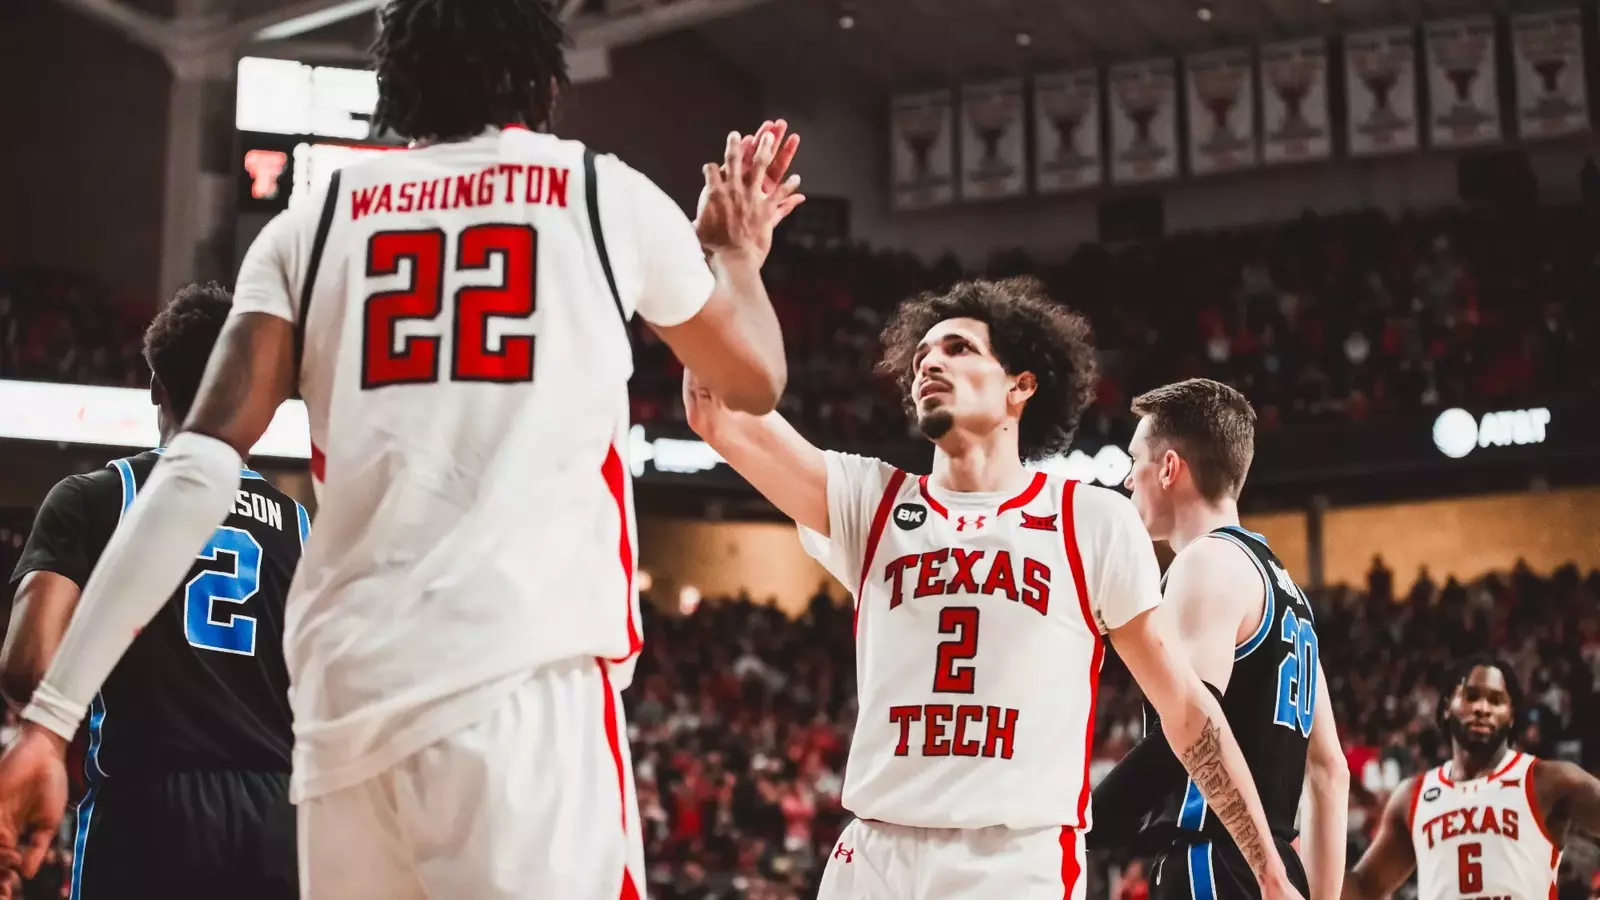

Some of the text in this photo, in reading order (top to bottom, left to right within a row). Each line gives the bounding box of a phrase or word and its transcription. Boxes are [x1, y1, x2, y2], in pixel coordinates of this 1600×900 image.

[351, 164, 569, 220] WASHINGTON
[361, 223, 537, 390] 22
[230, 489, 282, 531] SON
[897, 508, 923, 523] BK
[184, 525, 263, 656] 2
[884, 547, 1051, 616] TEXAS
[932, 606, 980, 694] 2
[1273, 605, 1319, 739] 20
[889, 704, 1019, 760] TECH
[1422, 805, 1519, 849] TEXAS
[1458, 842, 1483, 894] 6
